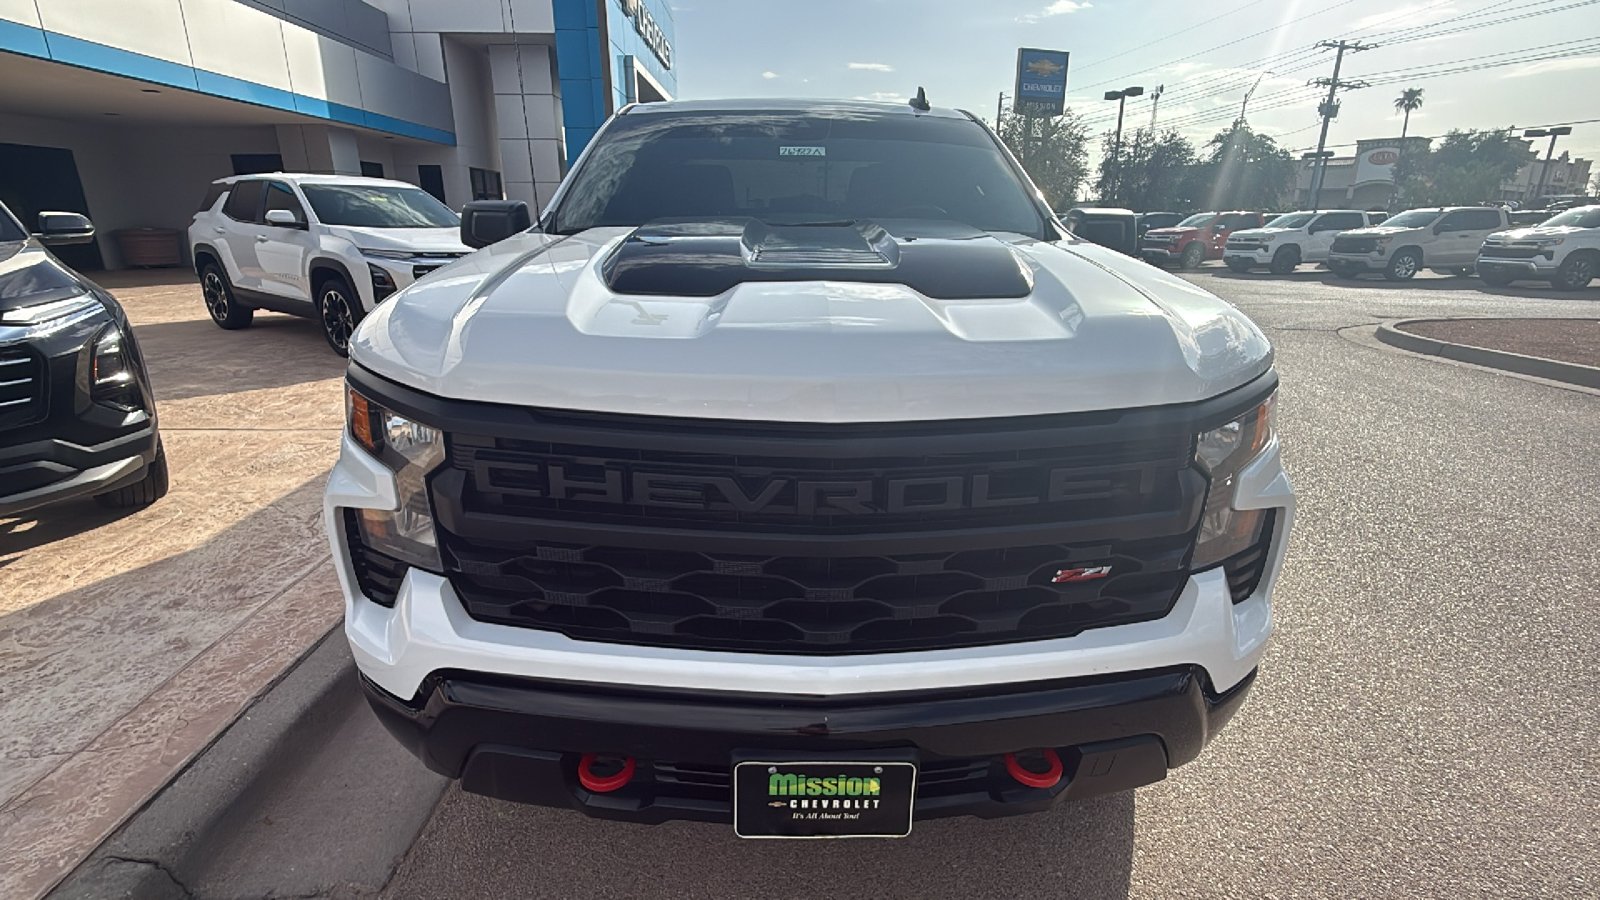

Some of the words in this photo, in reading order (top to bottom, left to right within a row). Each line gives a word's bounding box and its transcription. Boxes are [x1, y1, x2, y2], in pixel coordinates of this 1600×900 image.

[1023, 82, 1063, 93] CHEVROLET
[1026, 101, 1056, 111] MISSION
[474, 458, 1178, 514] CHEVROLET
[1051, 566, 1112, 582] Z71
[769, 773, 881, 796] Mission
[789, 799, 880, 809] CHEVROLET
[792, 812, 804, 820] It's
[806, 812, 817, 820] All
[819, 812, 842, 820] About
[843, 812, 860, 820] You!
